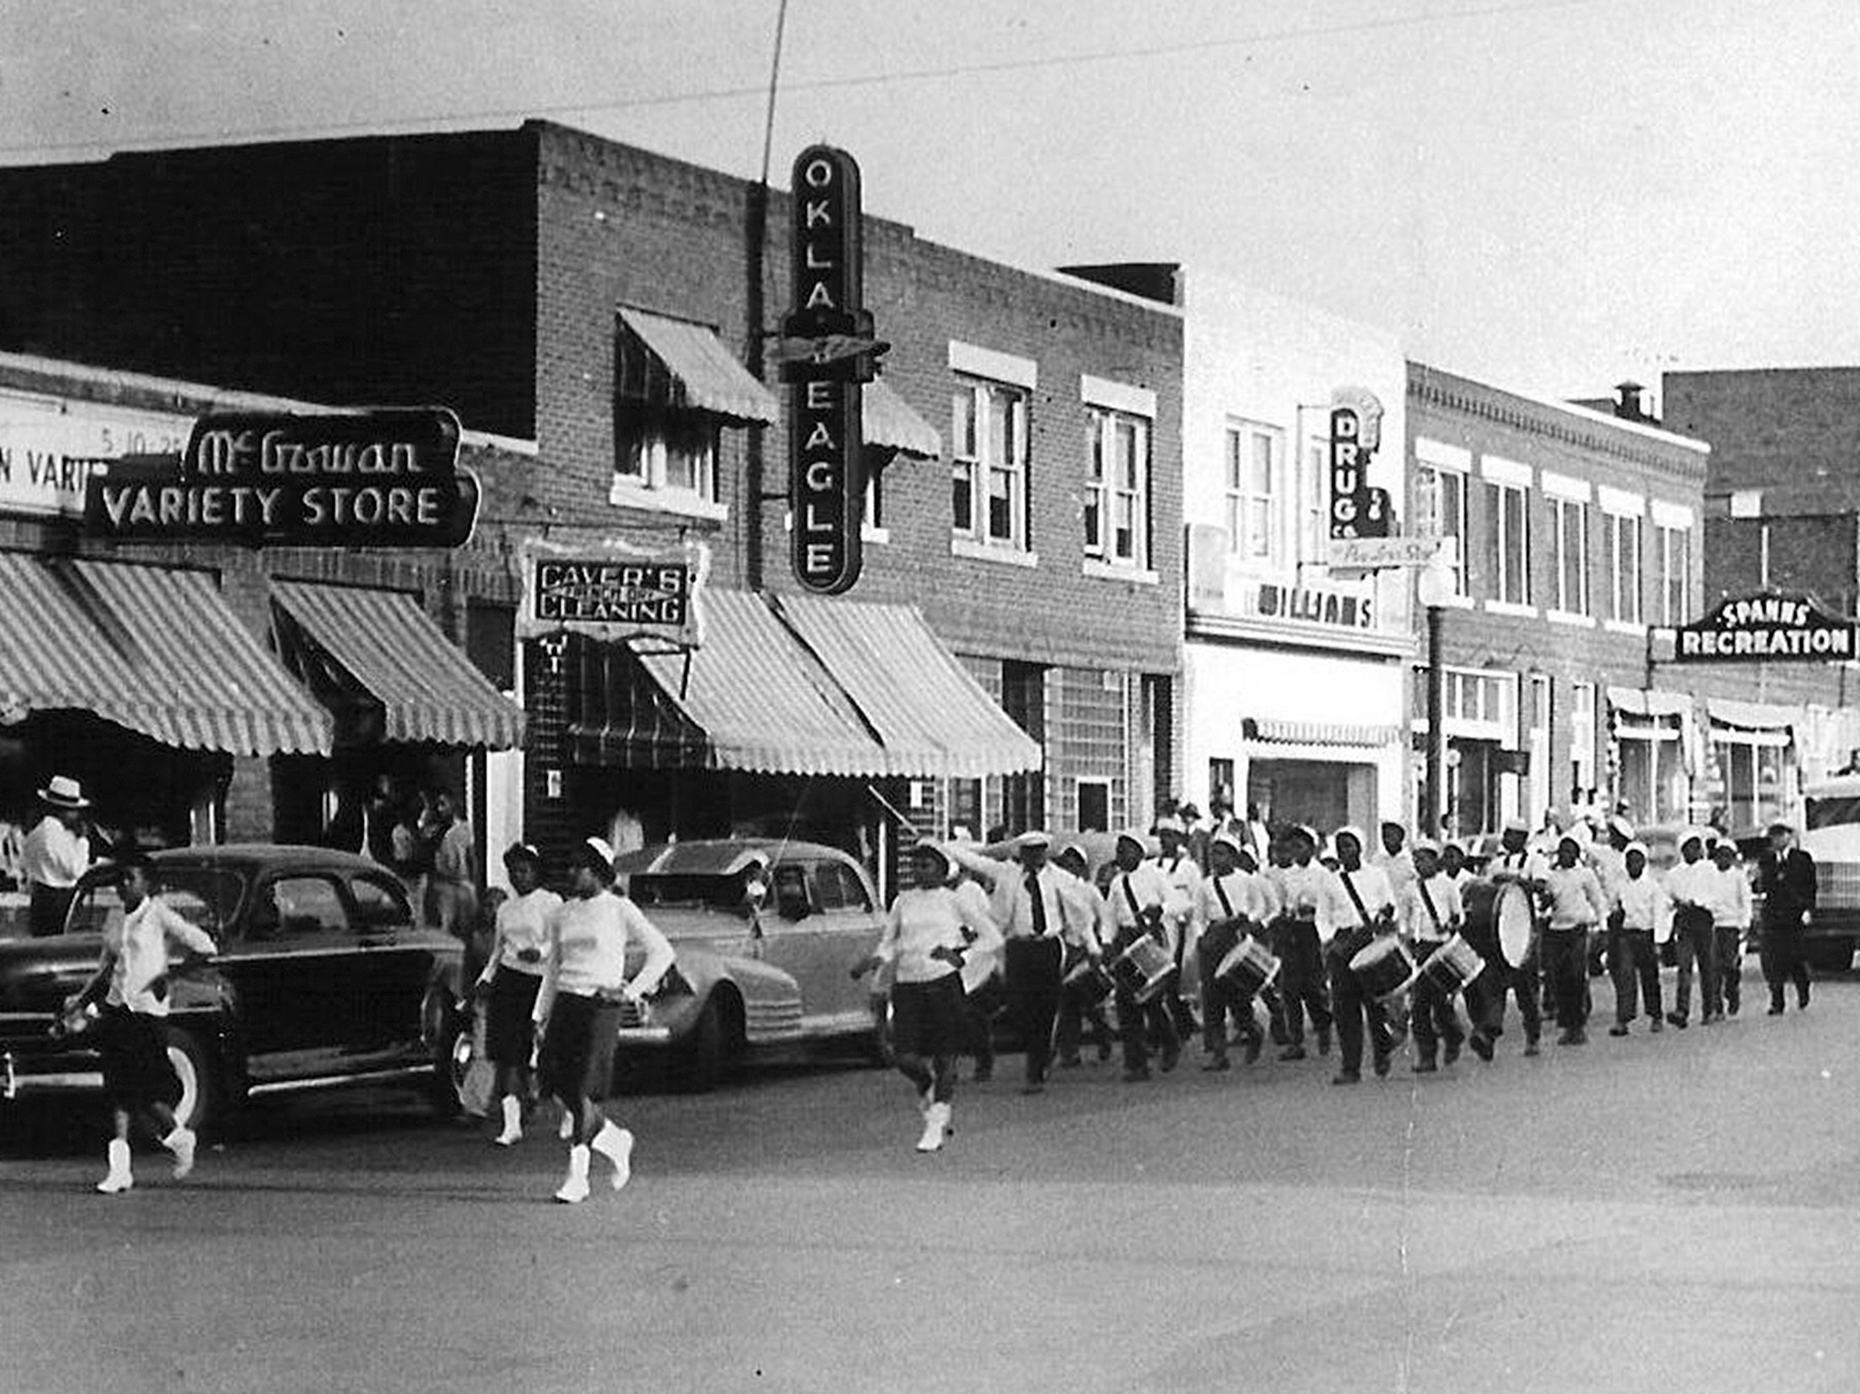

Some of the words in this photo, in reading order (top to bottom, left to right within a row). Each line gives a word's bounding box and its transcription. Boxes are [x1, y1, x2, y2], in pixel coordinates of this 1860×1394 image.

[806, 159, 834, 309] OKLA
[805, 381, 835, 573] EAGLE
[102, 486, 282, 527] VARIETY
[303, 486, 440, 526] STORE
[541, 565, 681, 593] CAVER'S
[540, 593, 679, 621] CLEANING
[1682, 628, 1849, 655] RECREATION
